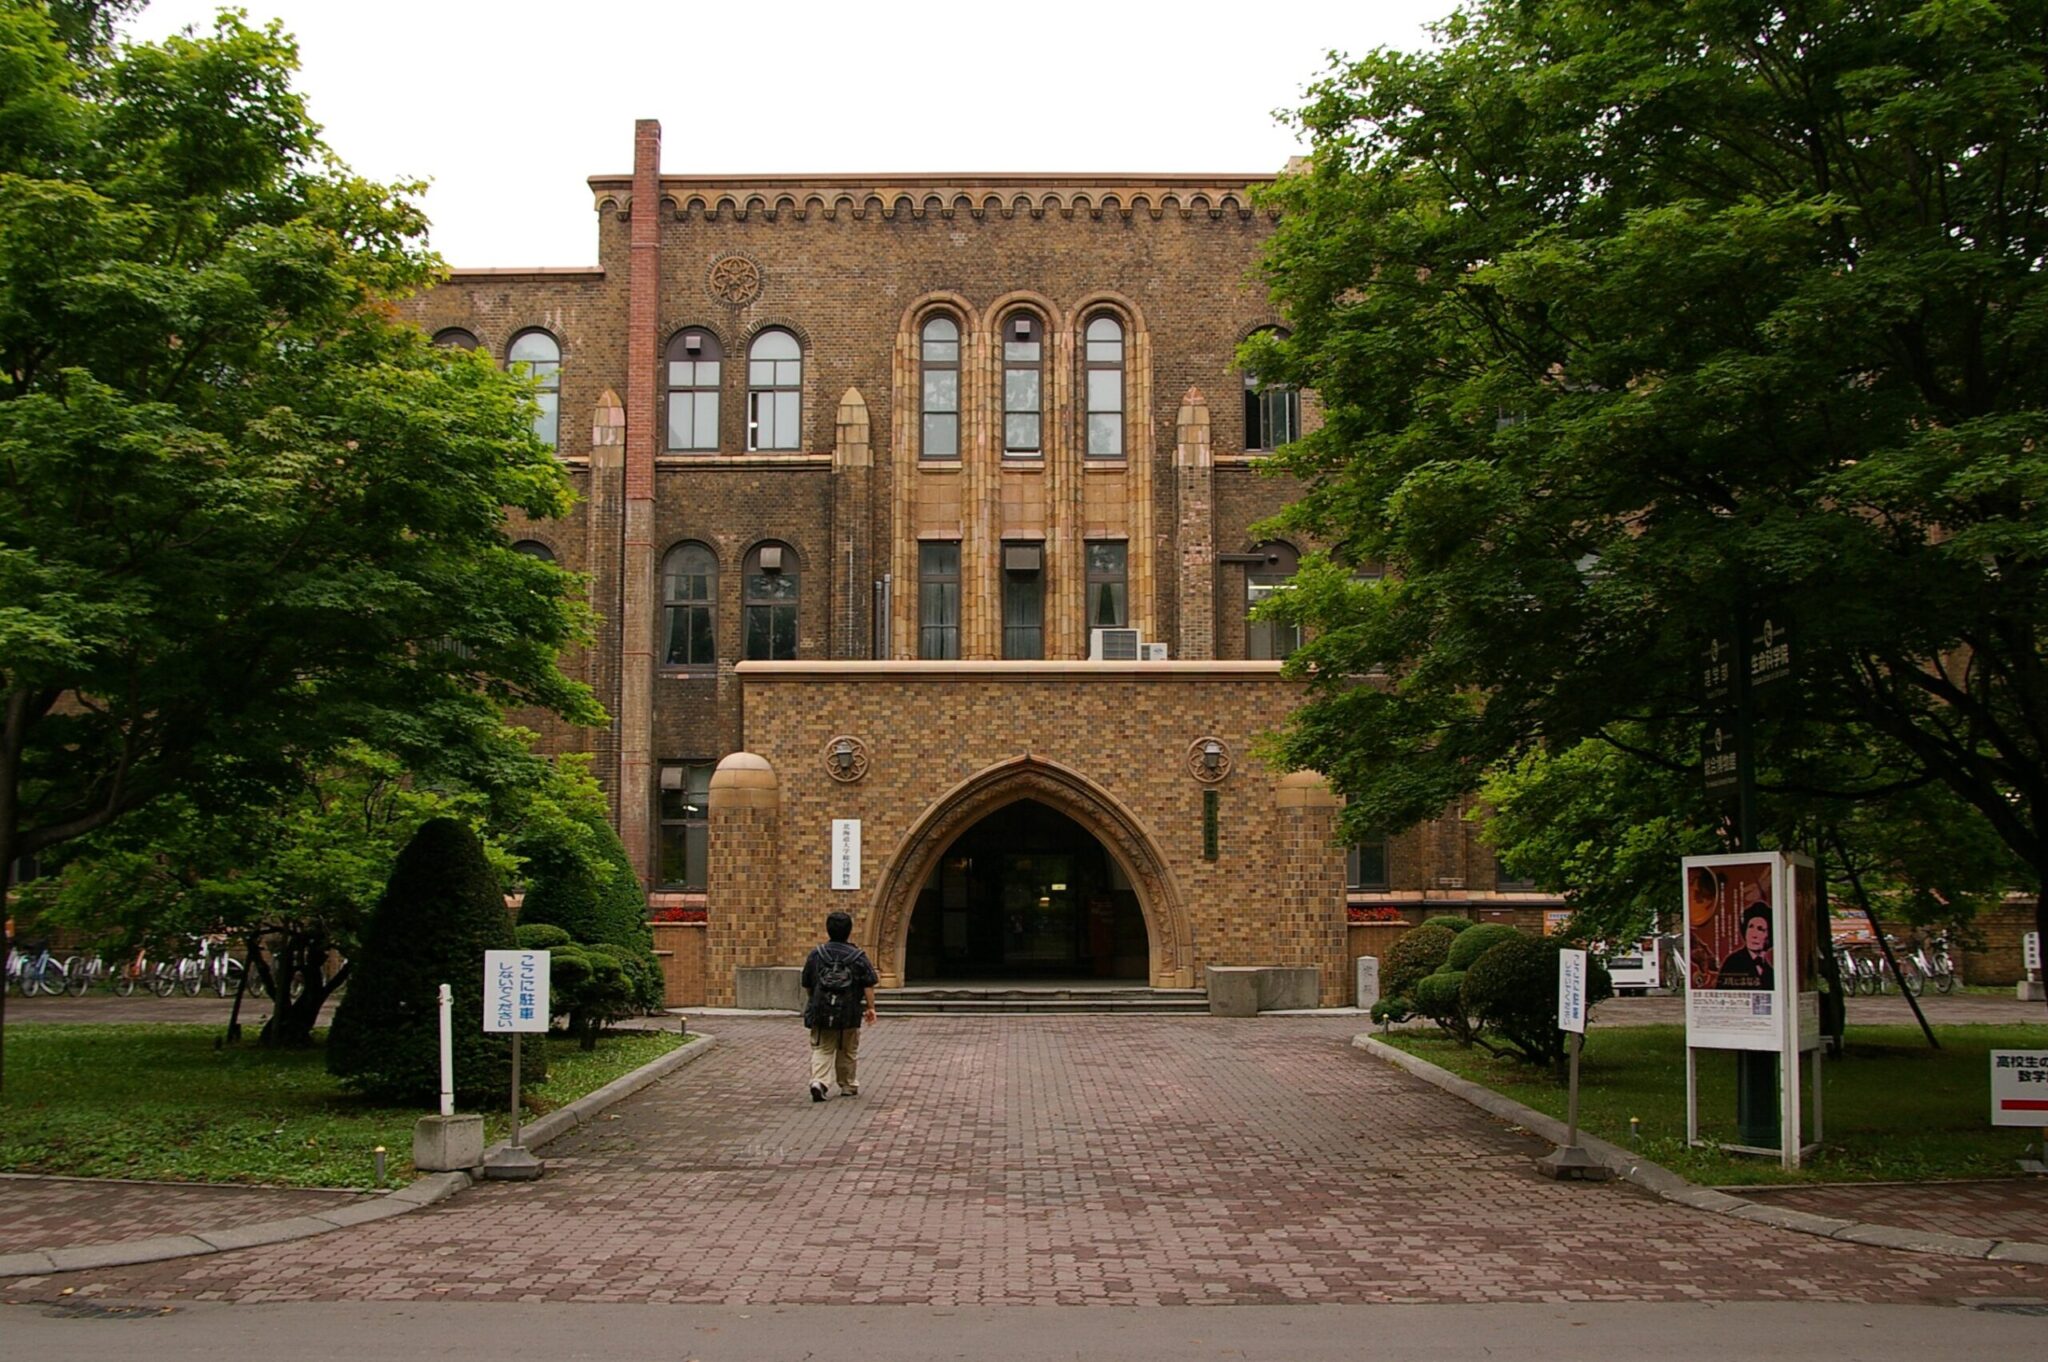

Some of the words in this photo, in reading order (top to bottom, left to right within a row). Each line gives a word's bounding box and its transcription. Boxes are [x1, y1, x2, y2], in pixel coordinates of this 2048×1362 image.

[498, 961, 513, 1028] しないでください
[519, 954, 536, 1020] ここに駐車
[2018, 1069, 2048, 1083] 数学
